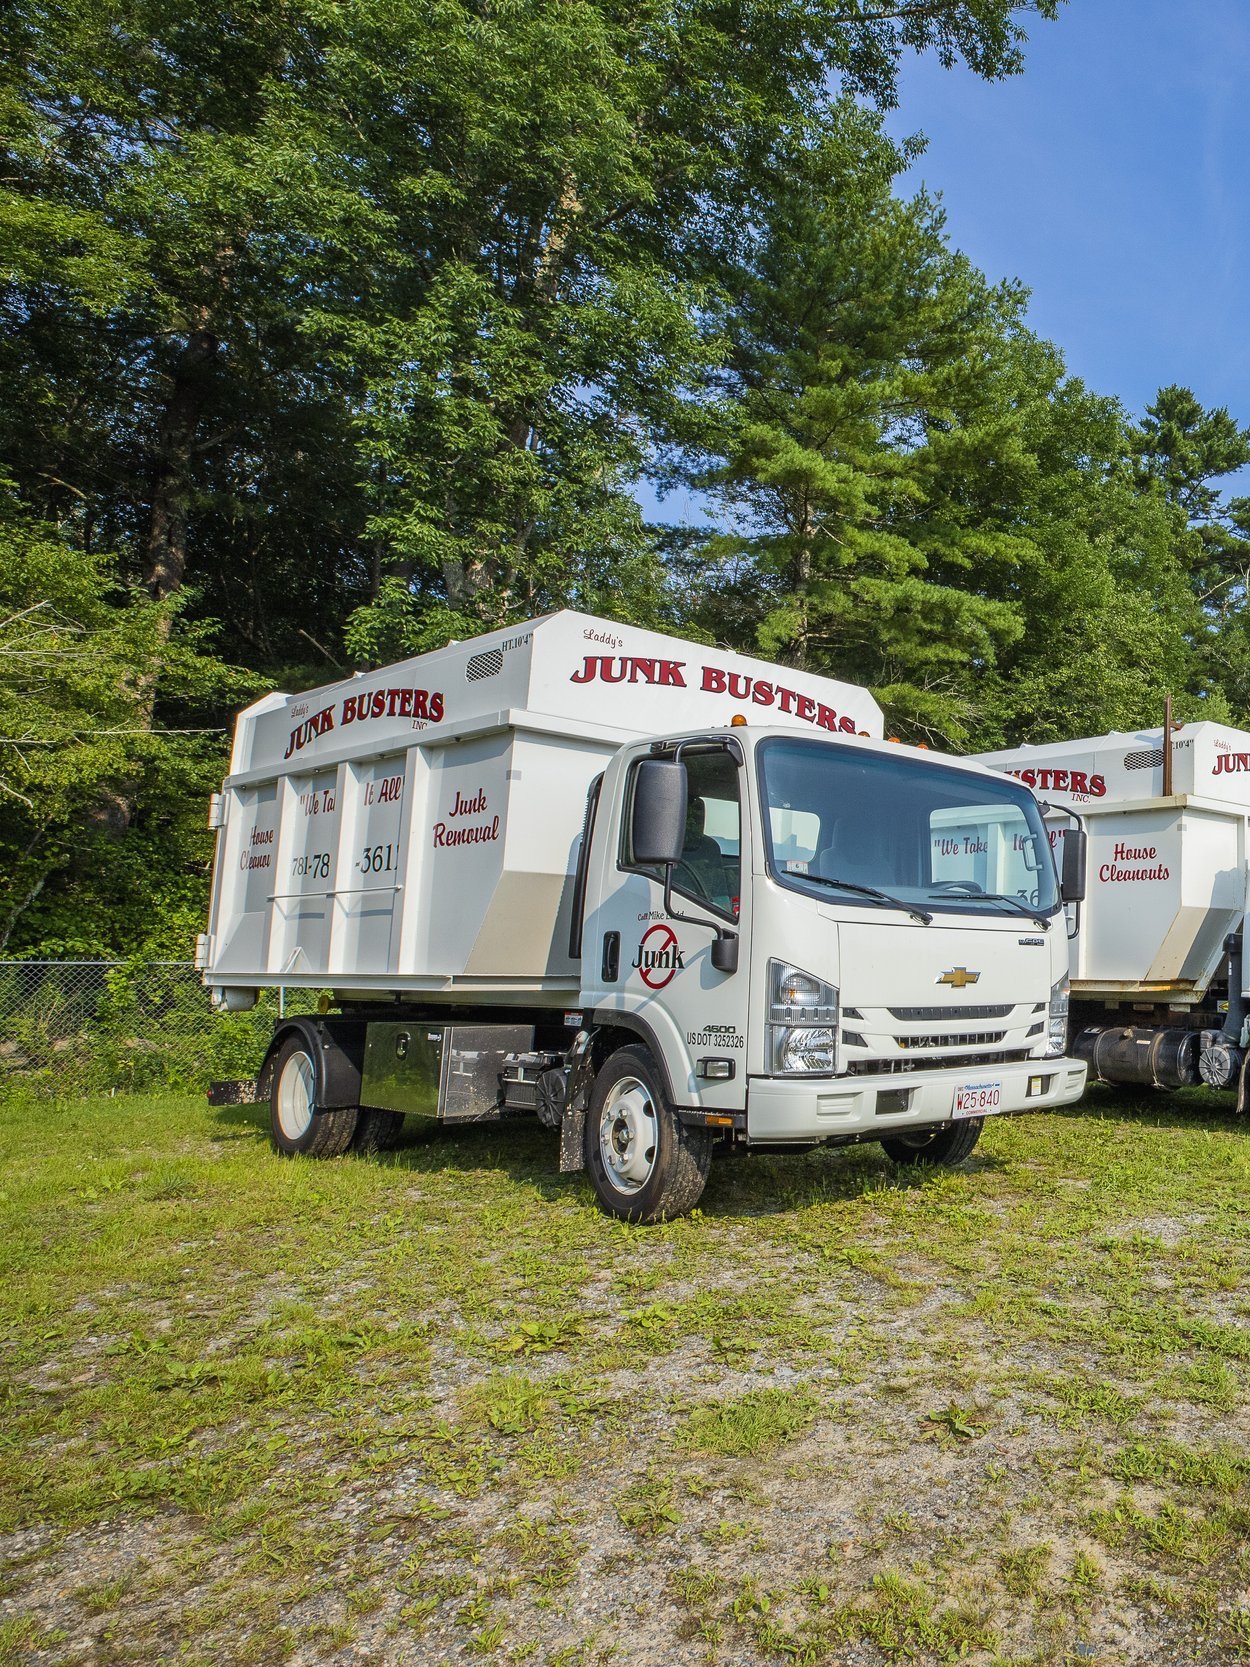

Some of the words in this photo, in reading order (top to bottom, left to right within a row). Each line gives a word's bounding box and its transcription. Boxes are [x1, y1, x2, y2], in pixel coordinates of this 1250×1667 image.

[583, 629, 623, 649] Laddy's
[570, 656, 687, 687] JUNK
[700, 666, 857, 735] BUSTERS
[284, 704, 336, 759] JUNK
[340, 688, 445, 727] BUSTERS
[448, 787, 488, 817] Junk
[1071, 793, 1091, 803] INC.
[249, 825, 274, 847] House
[433, 815, 500, 849] Removal
[934, 838, 959, 856] "We
[1113, 842, 1158, 862] House
[1099, 863, 1170, 882] Cleanouts
[649, 911, 664, 920] Mike
[632, 945, 685, 969] Junk
[703, 1025, 735, 1033] 4500
[714, 1034, 744, 1048] 3252326
